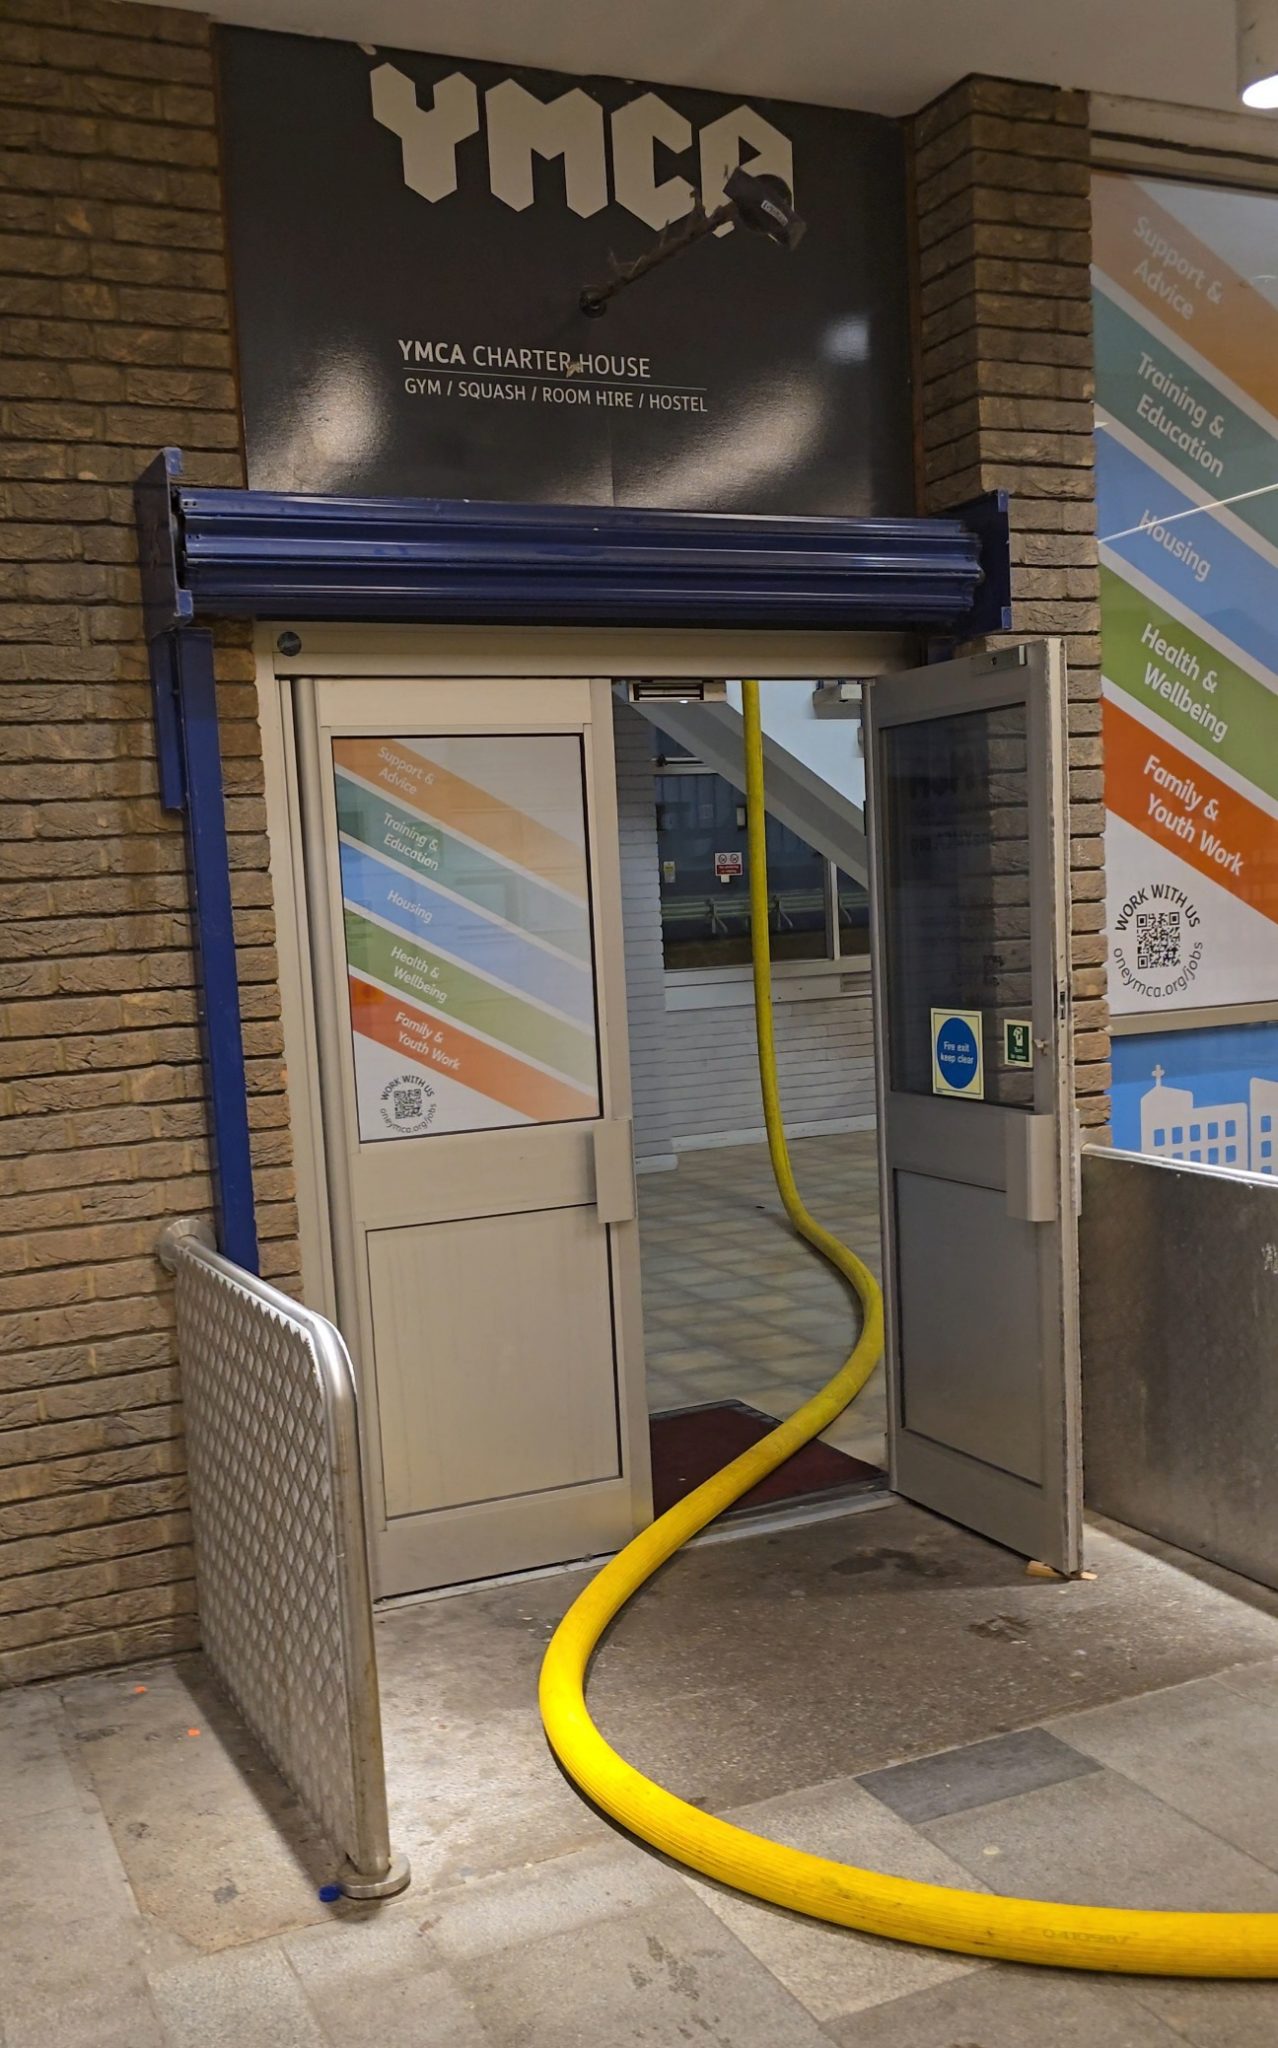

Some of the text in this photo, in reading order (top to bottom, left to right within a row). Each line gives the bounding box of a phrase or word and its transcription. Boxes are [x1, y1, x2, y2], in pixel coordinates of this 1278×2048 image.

[370, 62, 794, 238] YMCA
[1133, 216, 1222, 304] Support &
[1133, 259, 1193, 320] Advice
[398, 339, 651, 378] YMCA CHARTER HOUSE
[404, 377, 441, 396] GYM
[458, 381, 526, 400] SQUASH
[542, 387, 591, 405] ROOM
[596, 390, 634, 408] HIRE
[649, 394, 708, 412] HOSTEL
[1138, 352, 1224, 439] Training &
[1137, 394, 1223, 478] Education
[1138, 509, 1211, 582] Housing
[1141, 623, 1218, 693] Health &
[1144, 662, 1228, 743] Wellbeing
[377, 746, 435, 786] Support &
[378, 767, 417, 795] Advice
[1143, 754, 1219, 821] Family &
[383, 833, 439, 871] Education
[384, 812, 439, 852] Training &
[1147, 793, 1244, 876] Youth Work
[387, 889, 433, 924] Housing
[1114, 884, 1200, 931] WORK WITH US
[391, 946, 440, 980] Health &
[1113, 941, 1203, 998] oneymca.org/jobs
[393, 966, 448, 1004] Wellbeing
[394, 1011, 444, 1044] Family &
[957, 1043, 970, 1052] exit
[398, 1031, 461, 1071] Youth Work
[940, 1052, 974, 1064] keep clear
[380, 1074, 435, 1101] WORK WITH US
